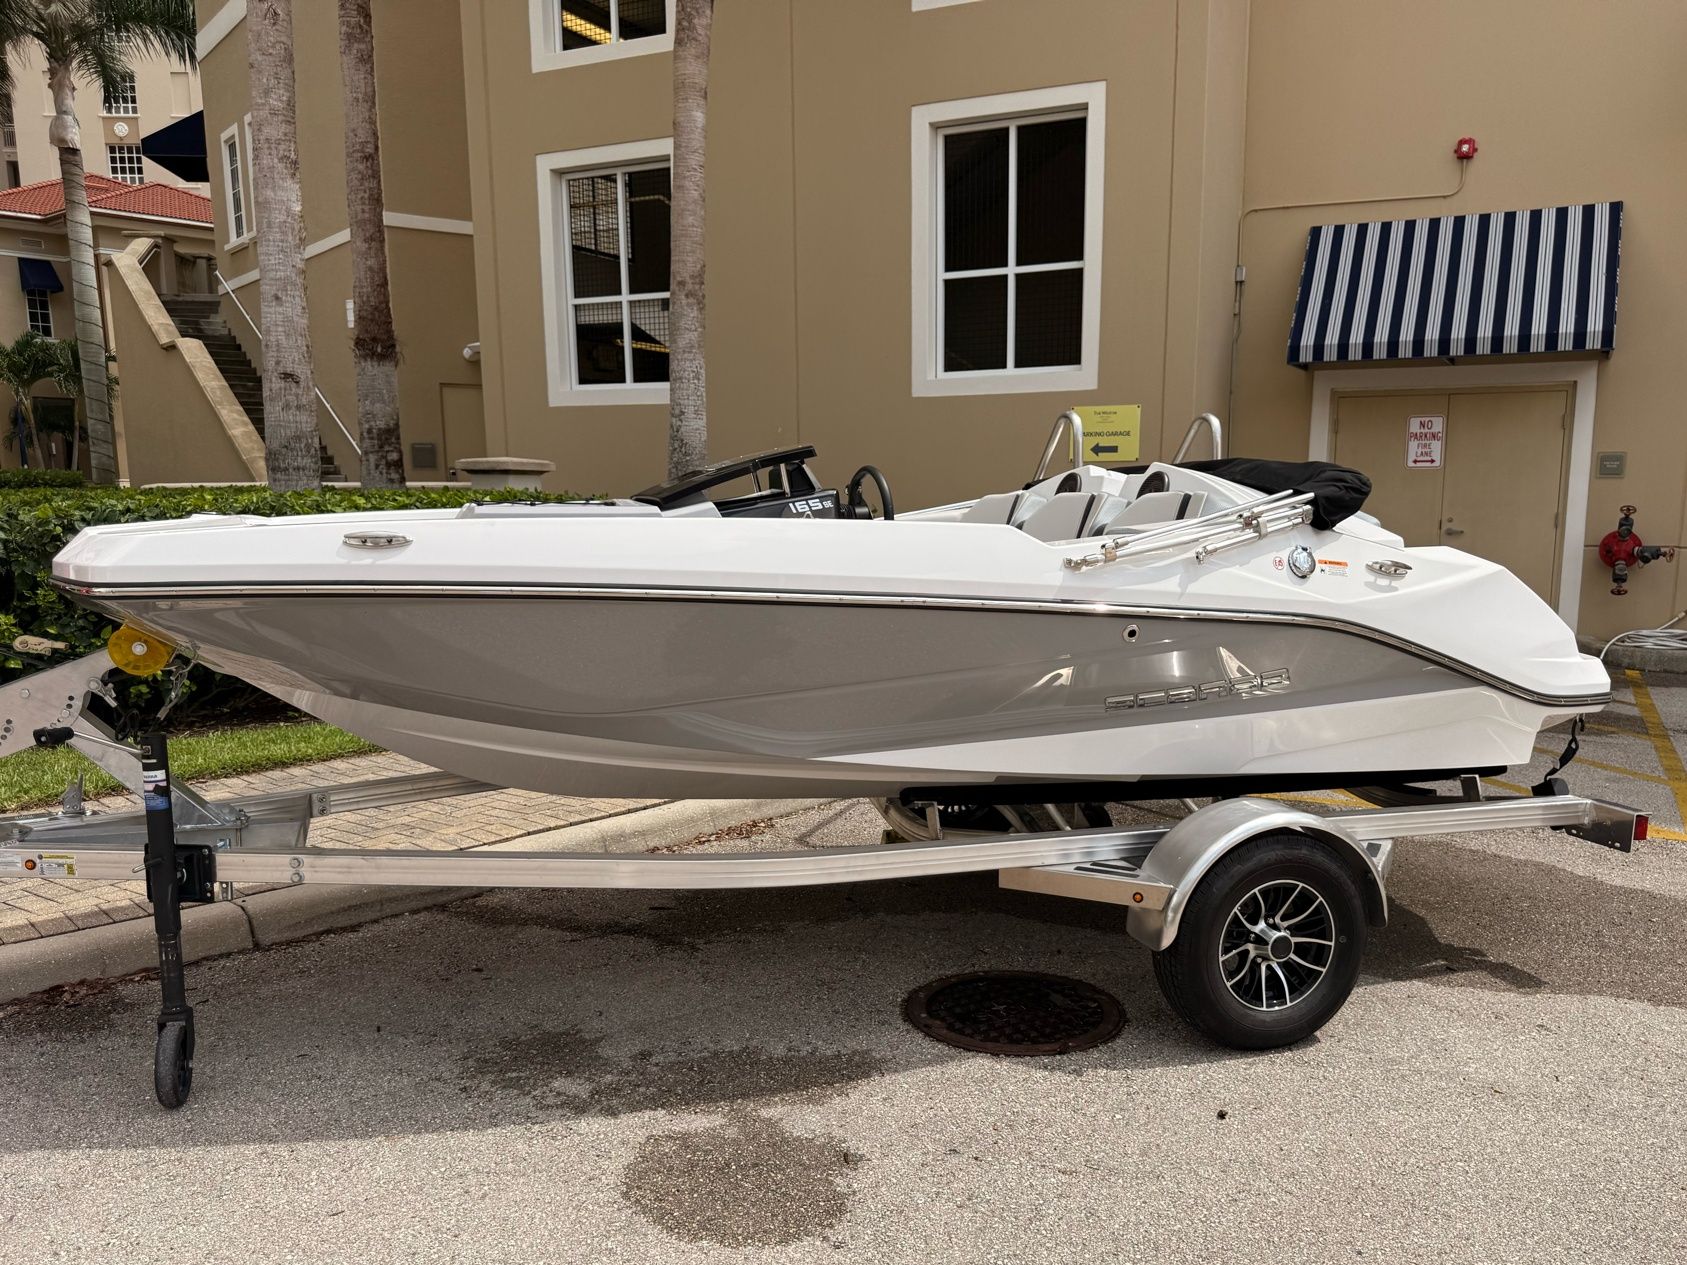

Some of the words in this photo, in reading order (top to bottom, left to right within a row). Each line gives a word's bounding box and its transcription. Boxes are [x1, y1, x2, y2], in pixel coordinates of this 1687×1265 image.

[1419, 419, 1433, 430] NO
[1410, 431, 1441, 441] PARKING
[1417, 442, 1432, 450] FIRE
[1415, 450, 1433, 458] LANE
[788, 498, 823, 513] 165
